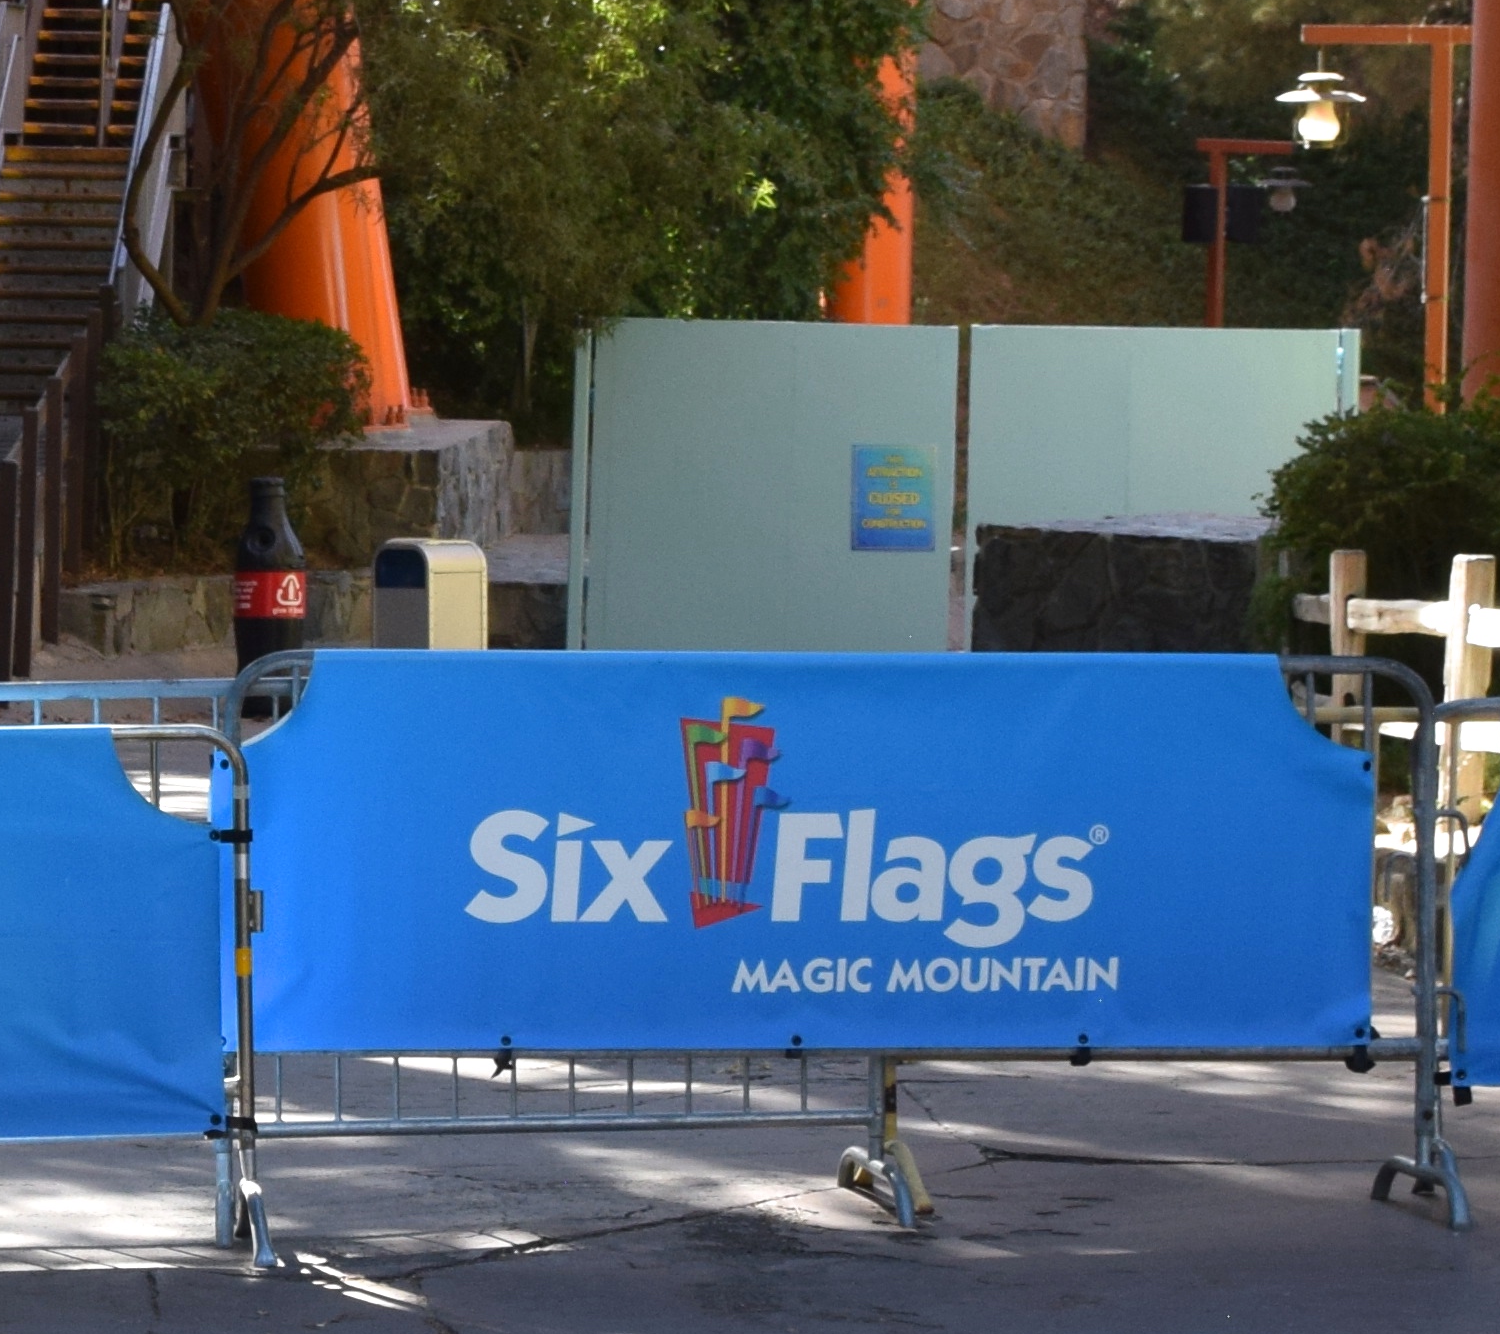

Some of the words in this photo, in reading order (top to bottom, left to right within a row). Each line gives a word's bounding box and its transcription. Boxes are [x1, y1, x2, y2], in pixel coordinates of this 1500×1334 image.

[868, 491, 920, 505] CLOSED
[463, 808, 674, 924] Six
[730, 957, 873, 994] MAGIC
[886, 956, 1120, 993] MOUNTAIN
